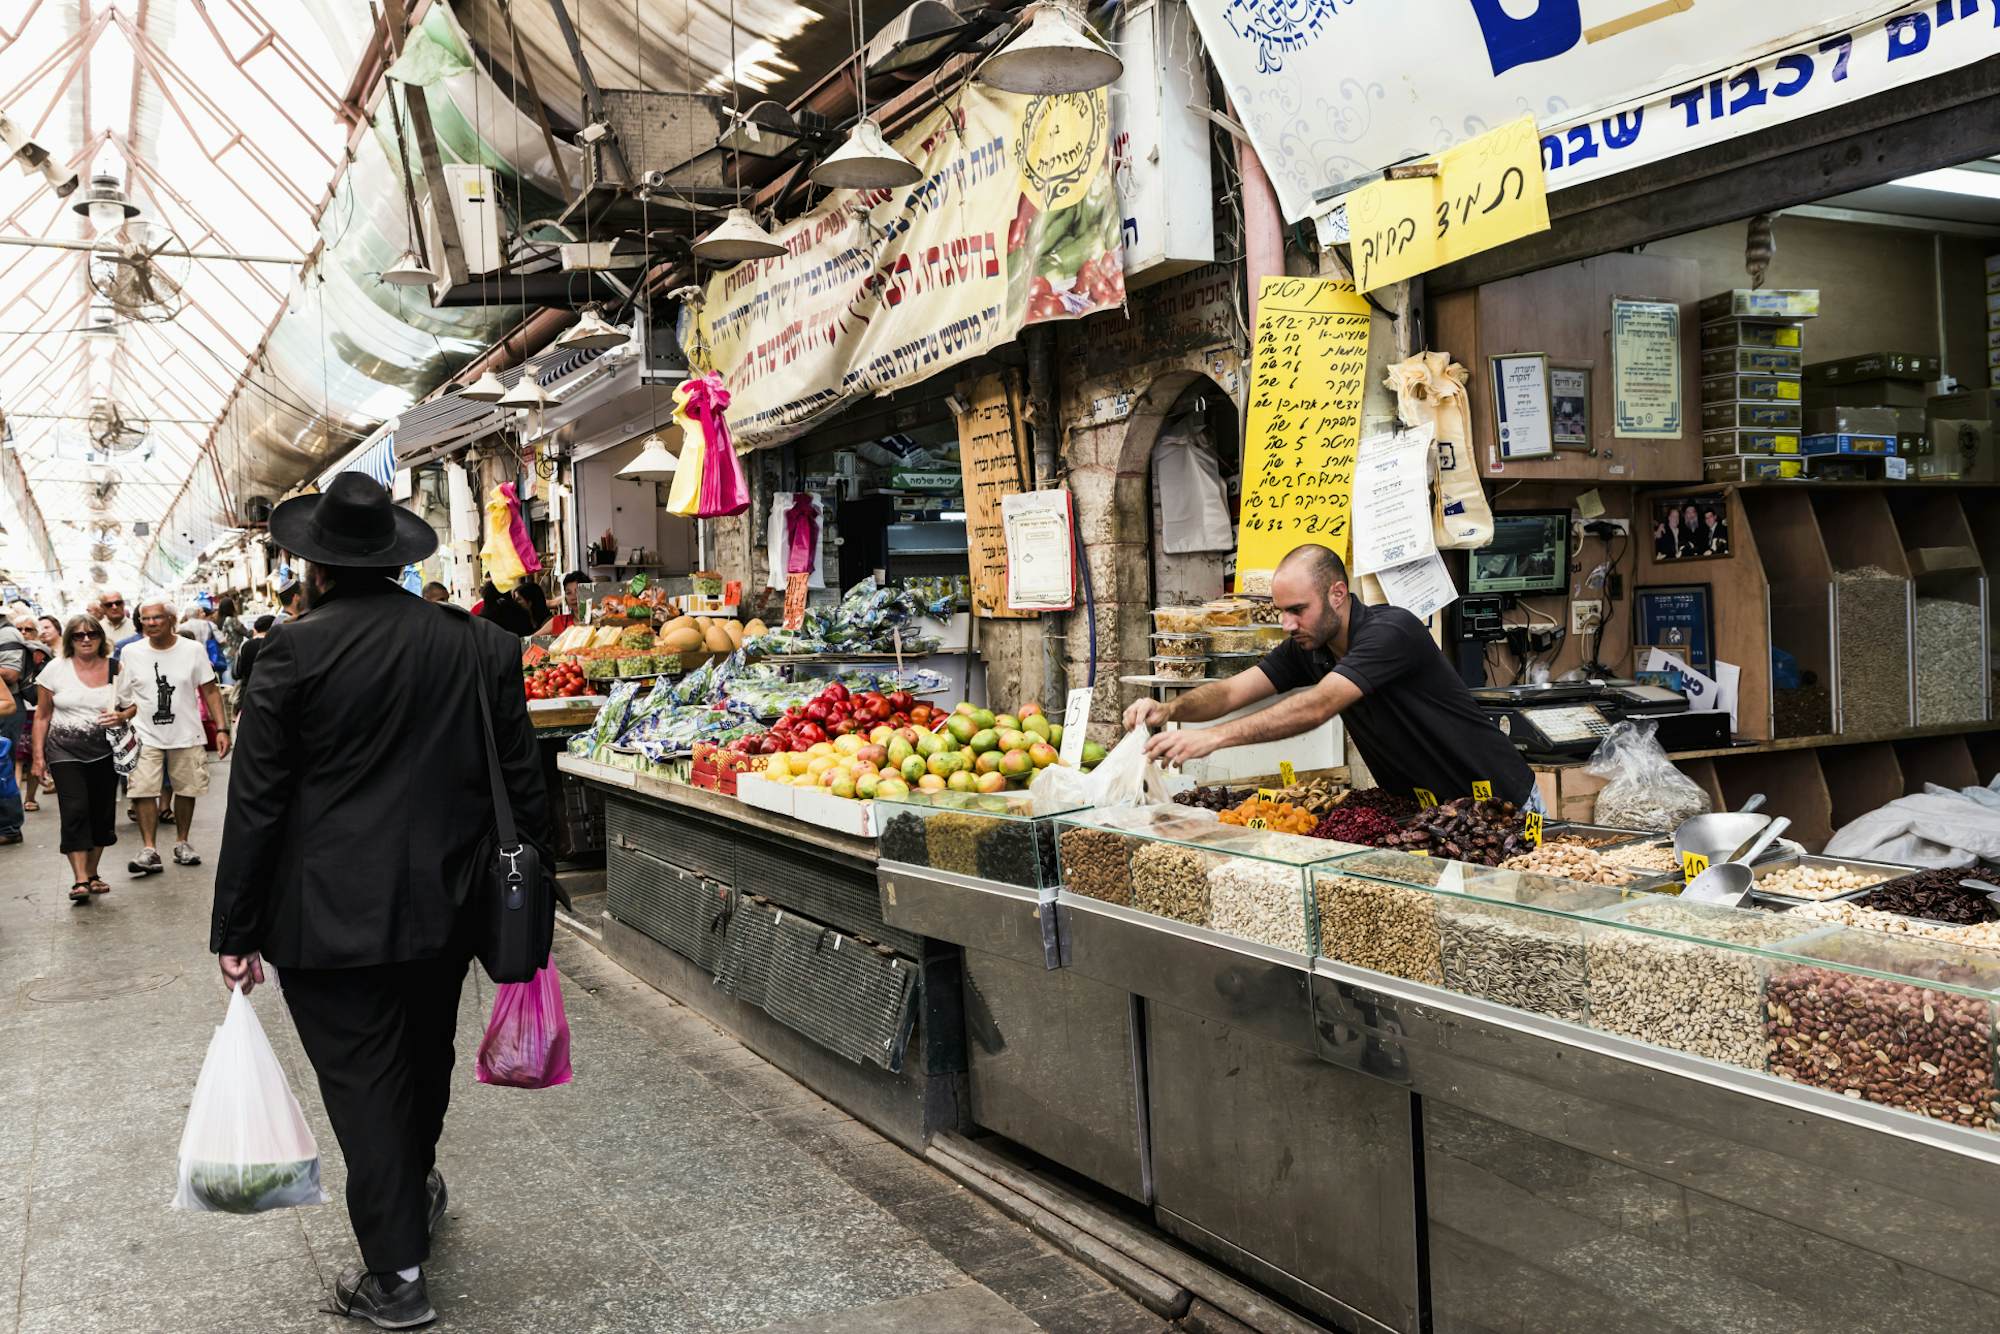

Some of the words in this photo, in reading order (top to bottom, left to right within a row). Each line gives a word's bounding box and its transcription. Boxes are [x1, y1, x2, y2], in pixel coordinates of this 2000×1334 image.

[970, 136, 1006, 186] חנות
[1436, 166, 1524, 240] תמיד
[1294, 436, 1308, 451] 5
[1320, 435, 1355, 449] חיטה
